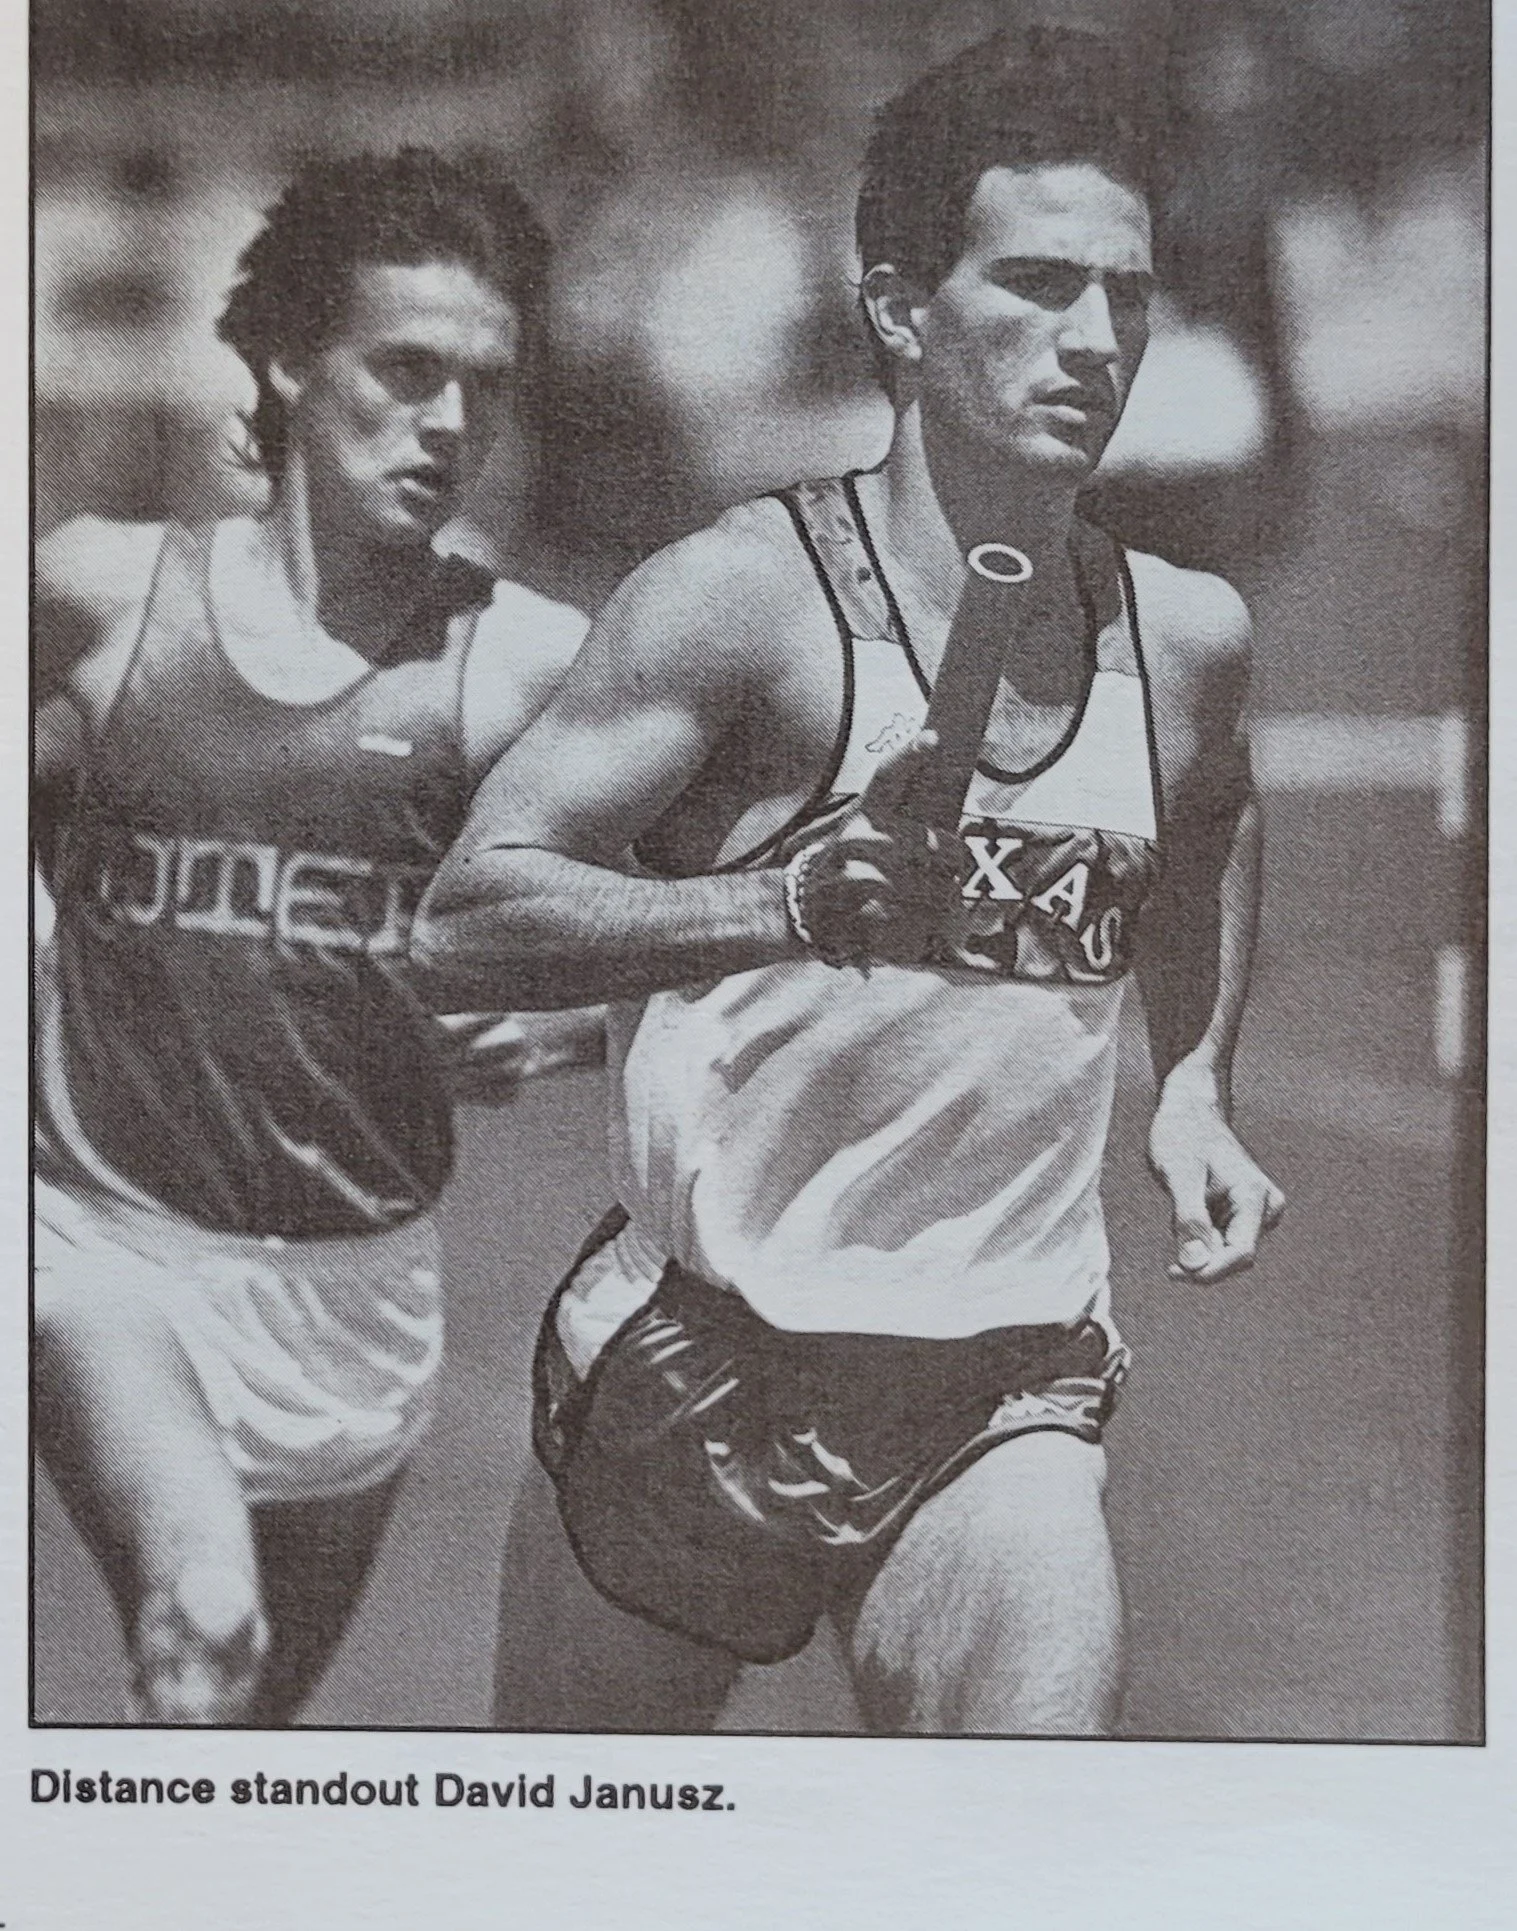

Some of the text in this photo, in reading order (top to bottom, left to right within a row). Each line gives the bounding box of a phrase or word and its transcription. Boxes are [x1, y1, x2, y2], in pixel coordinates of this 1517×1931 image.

[961, 835, 1122, 970] XAS
[30, 1768, 735, 1811] Distance standout David Janusz.
